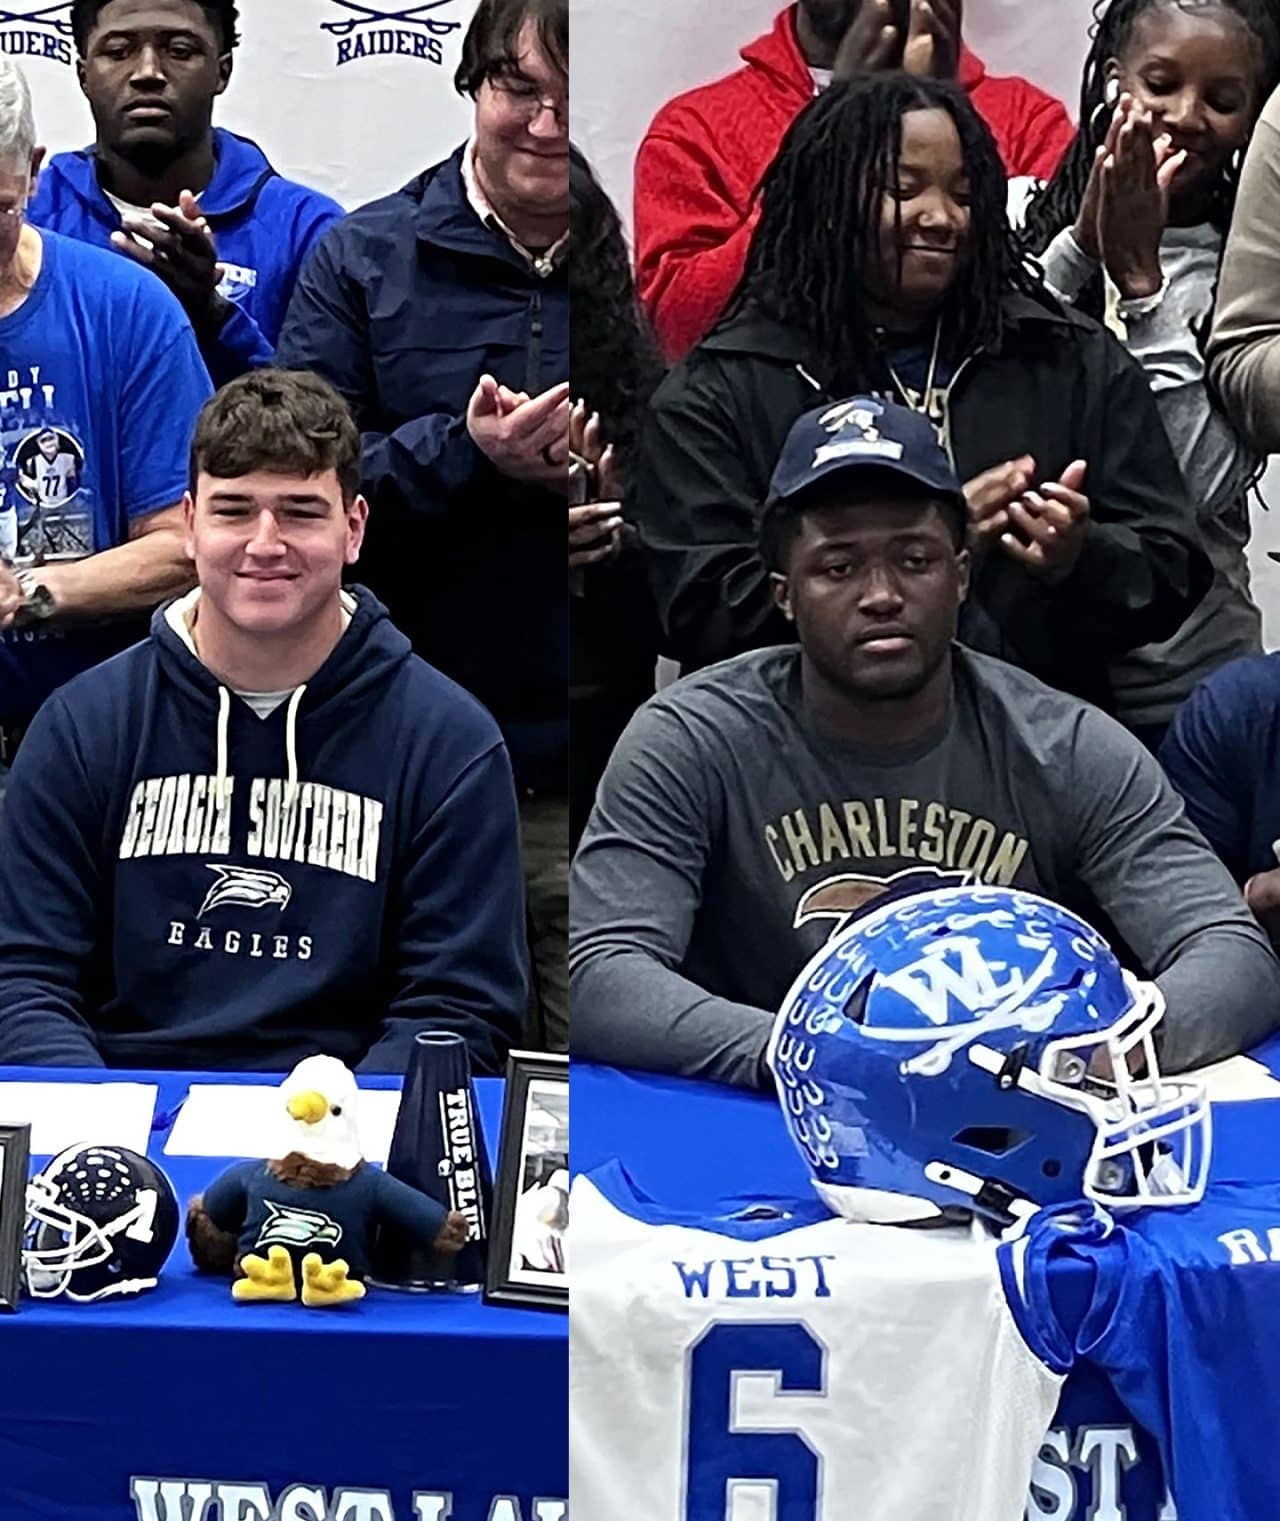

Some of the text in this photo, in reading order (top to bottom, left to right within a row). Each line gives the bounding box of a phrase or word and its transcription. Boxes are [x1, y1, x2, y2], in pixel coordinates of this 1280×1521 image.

[336, 30, 443, 66] RAIDERS
[119, 773, 384, 883] GEORGIA SOUTHERN
[765, 797, 1029, 886] CHARLESTON
[168, 921, 313, 960] EAGLES
[445, 1088, 473, 1164] TRUE
[673, 1255, 835, 1299] WEST
[684, 1318, 829, 1521] 6
[1022, 1425, 1140, 1521] ST
